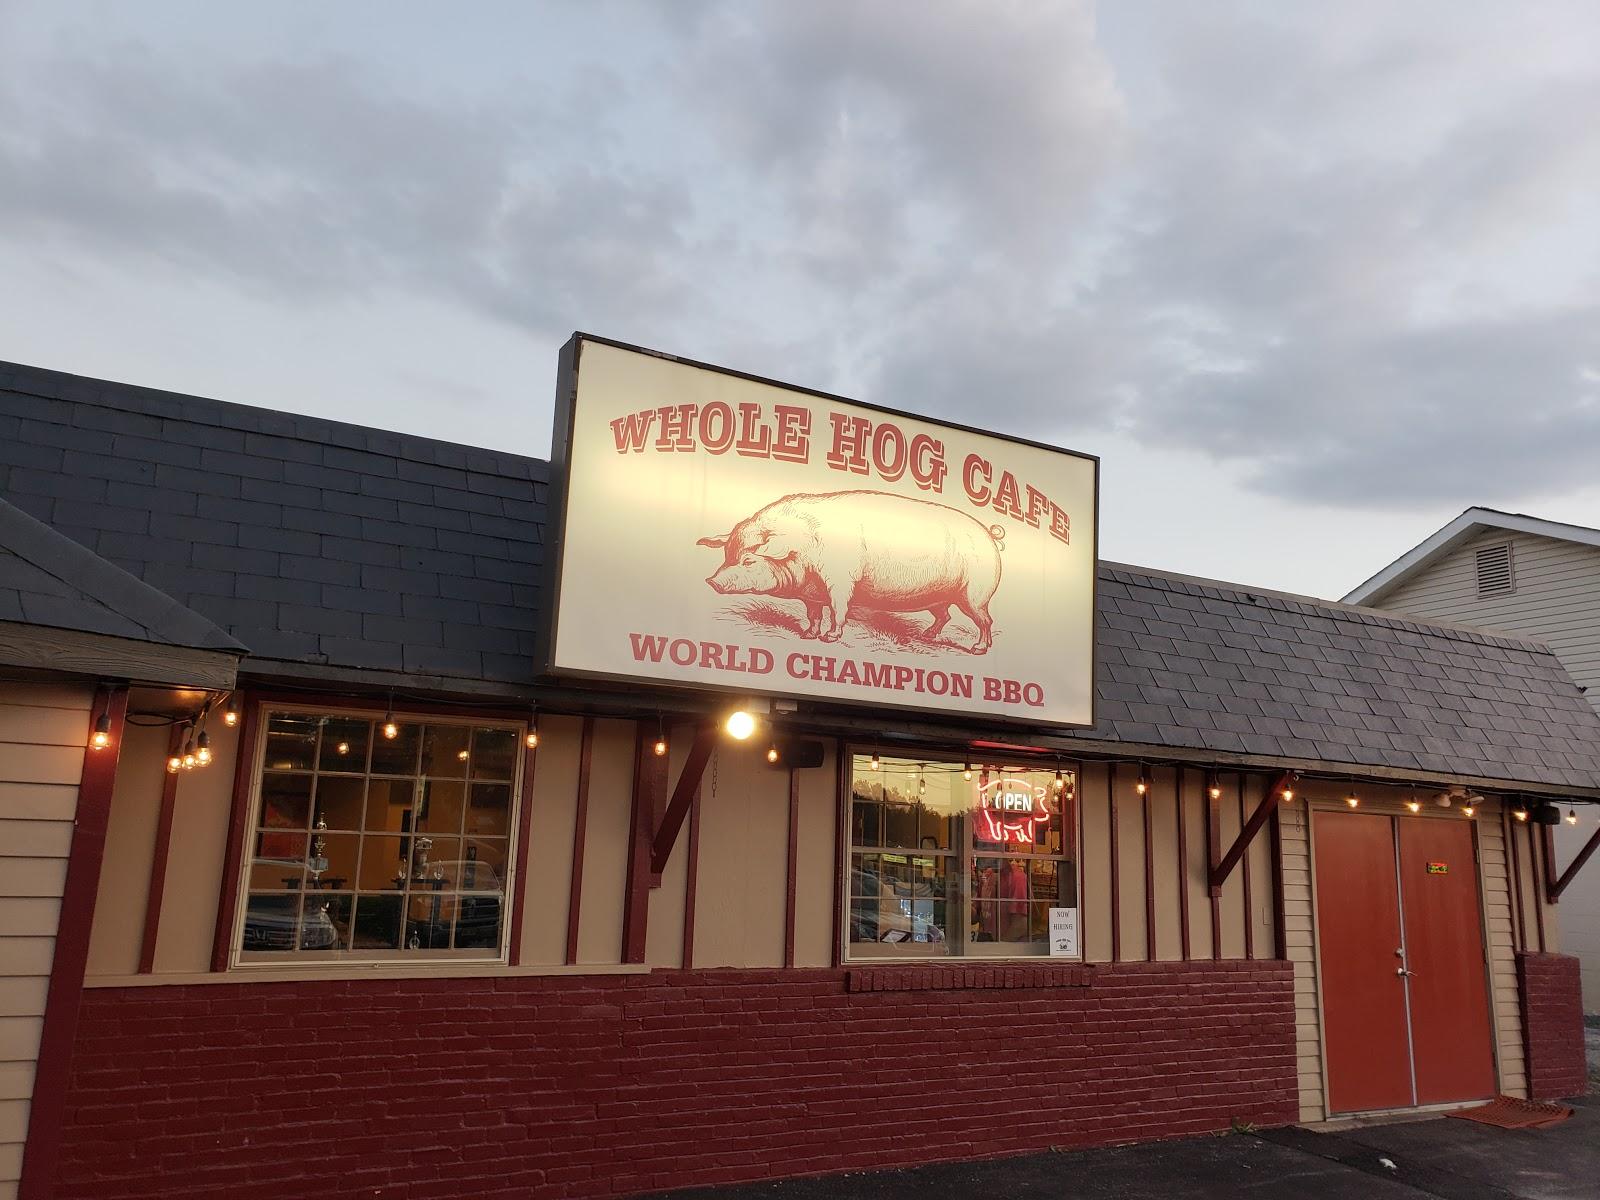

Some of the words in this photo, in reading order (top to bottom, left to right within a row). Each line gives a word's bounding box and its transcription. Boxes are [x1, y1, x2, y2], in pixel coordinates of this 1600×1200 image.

[609, 401, 812, 465] WHOLE
[827, 412, 948, 494] HOG
[962, 453, 1070, 546] CAFE
[629, 633, 775, 675] WORLD
[786, 652, 974, 699] CHAMPION
[982, 676, 1046, 708] BBQ
[995, 790, 1032, 812] OPEN
[1056, 910, 1070, 918] NOW
[1053, 923, 1073, 931] HIRING
